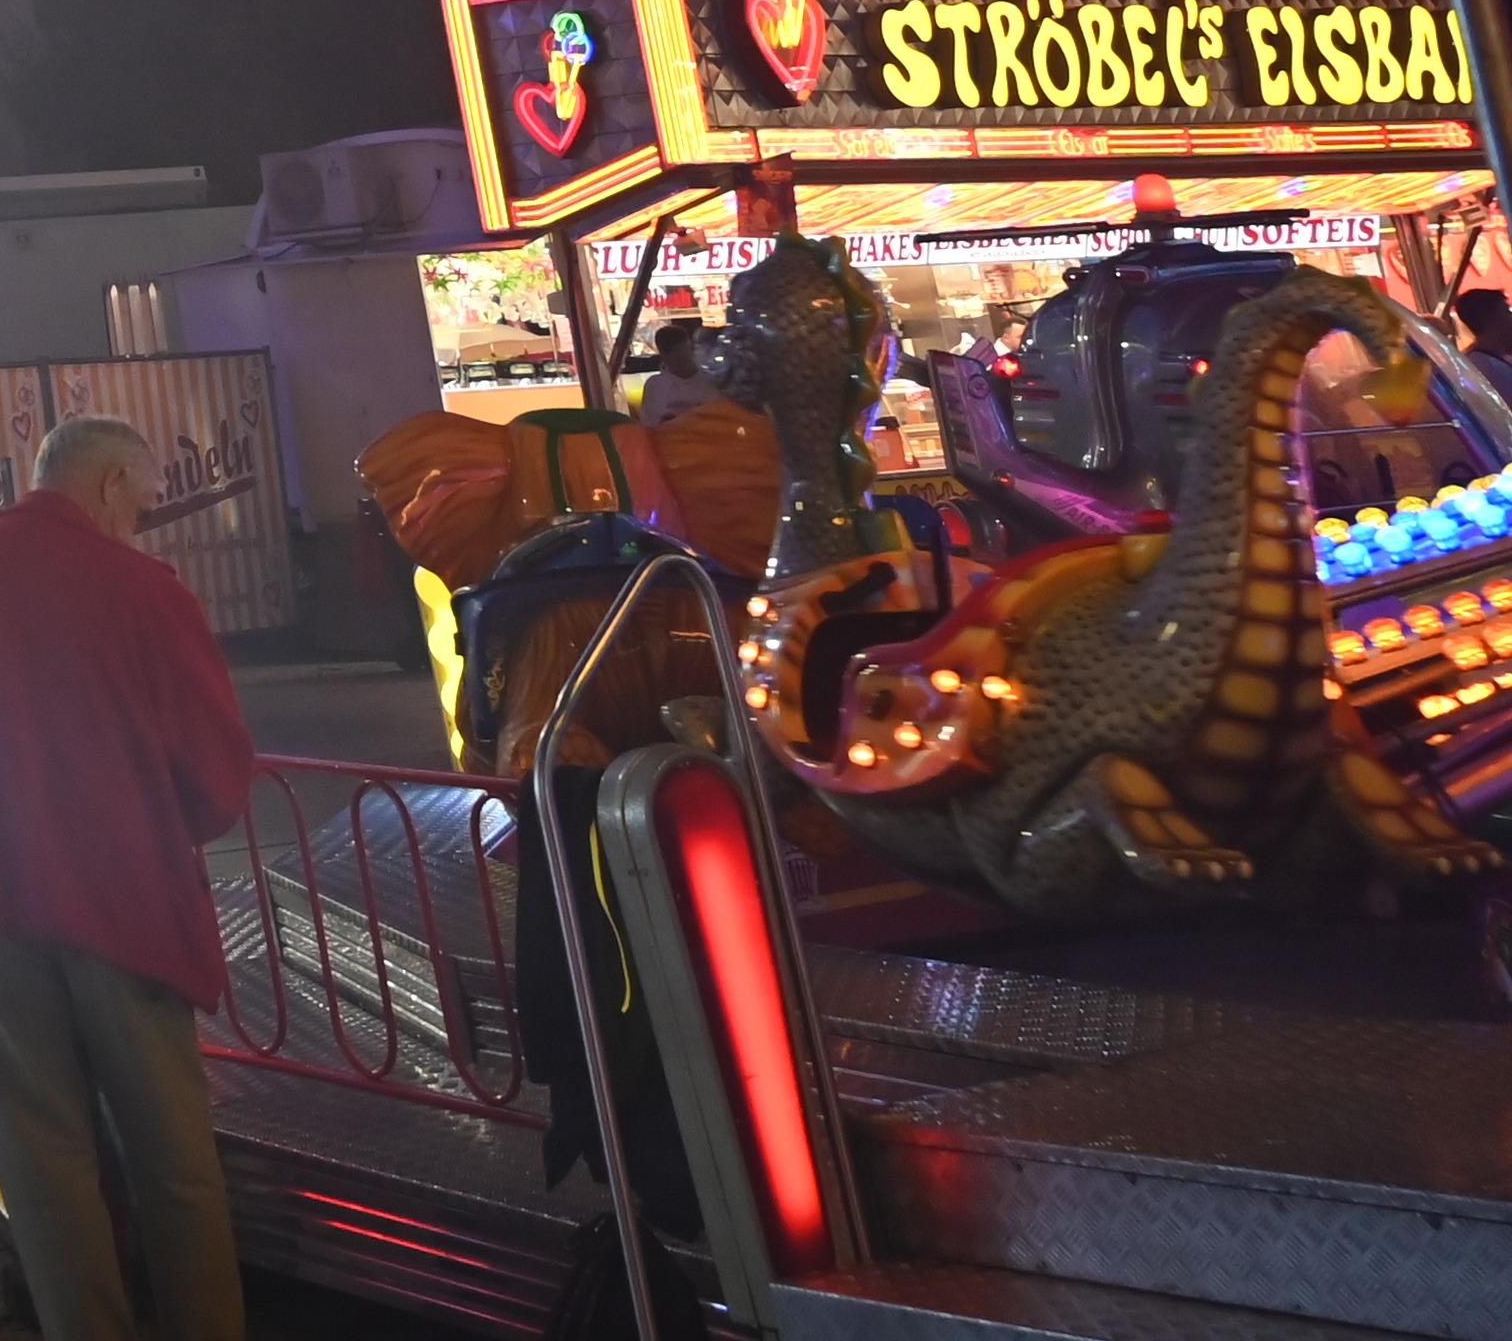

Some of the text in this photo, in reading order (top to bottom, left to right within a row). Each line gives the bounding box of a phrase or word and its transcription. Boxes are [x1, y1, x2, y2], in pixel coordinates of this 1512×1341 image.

[1241, 216, 1376, 247] SOFTEIS
[592, 240, 754, 275] LUH EIS
[156, 418, 254, 504] ndeln
